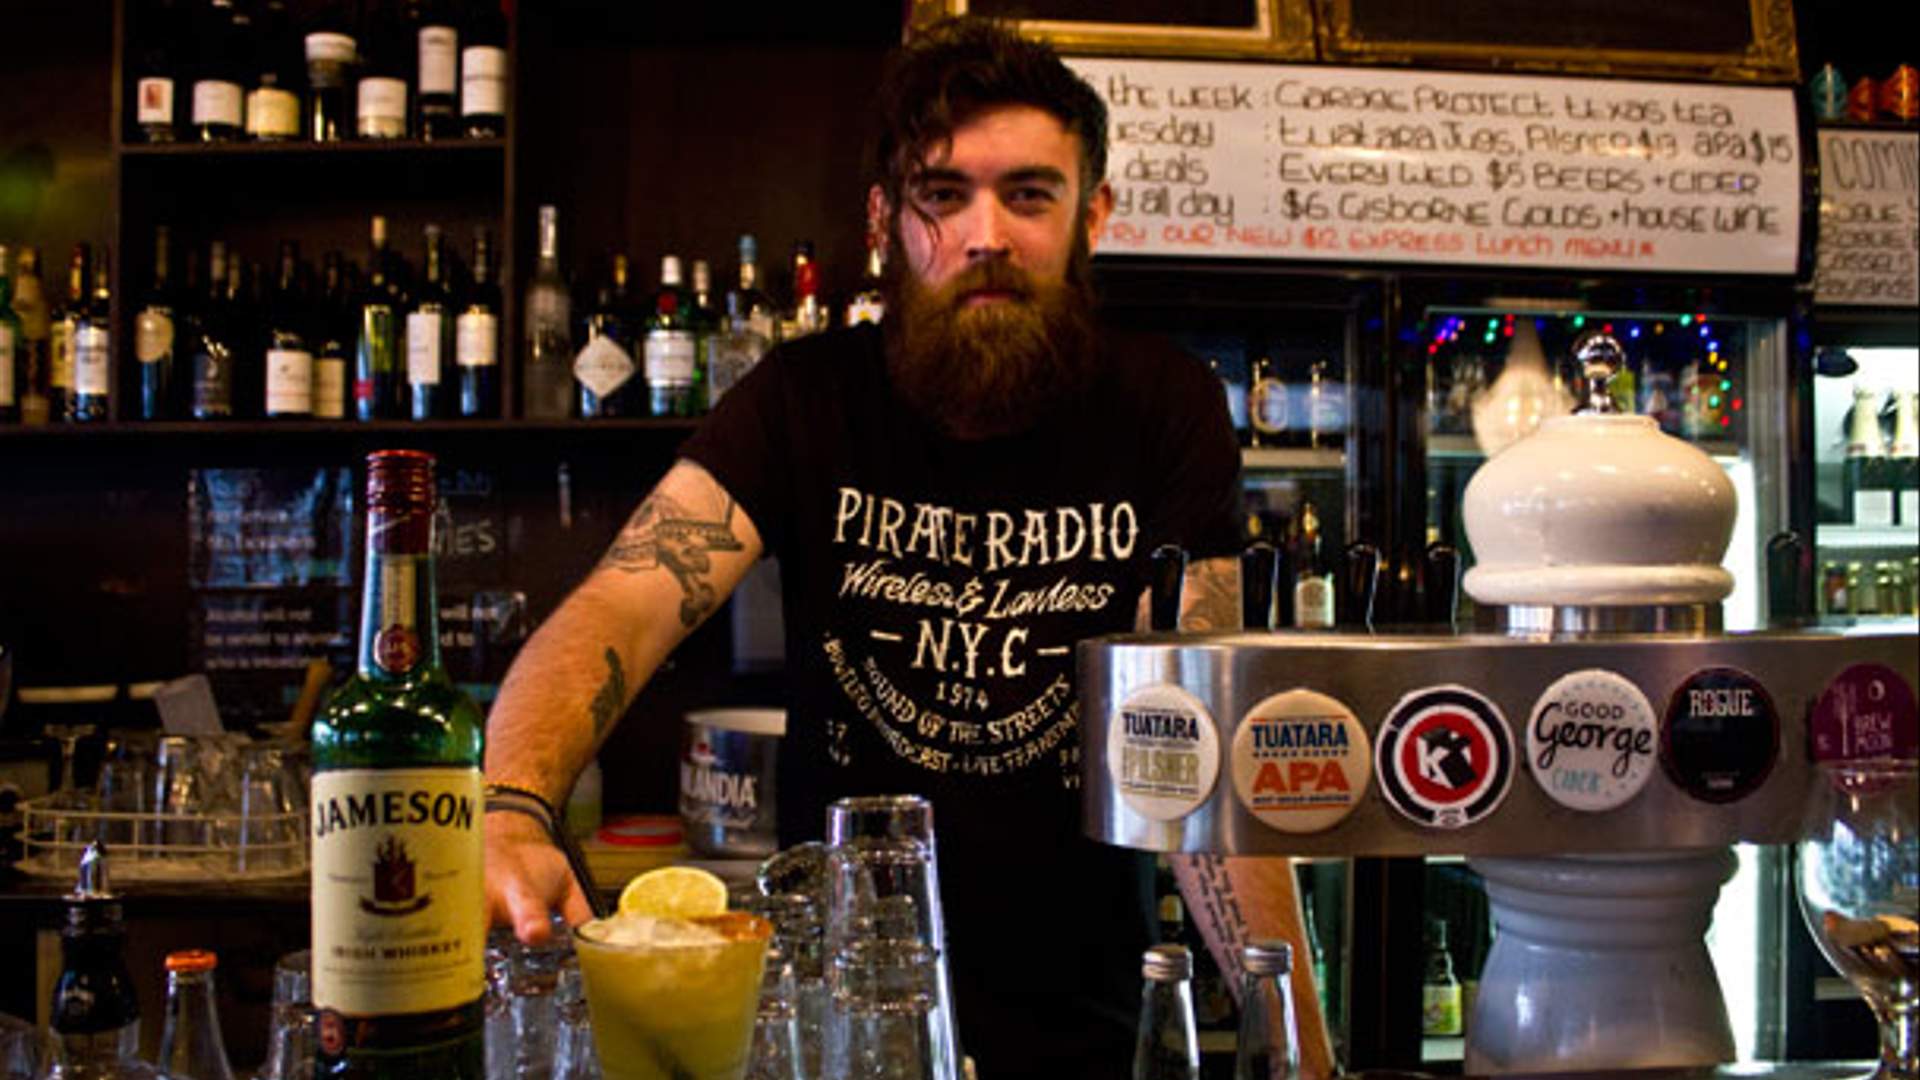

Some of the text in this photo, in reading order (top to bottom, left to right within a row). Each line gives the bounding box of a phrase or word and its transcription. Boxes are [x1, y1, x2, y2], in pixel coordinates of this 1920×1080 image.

[833, 487, 1139, 571] PIRATE RADIO
[935, 681, 988, 712] 1974
[949, 719, 984, 745] THE
[987, 673, 1070, 743] STREETS
[1564, 701, 1625, 720] GOOD
[1688, 688, 1756, 718] ROGUE
[1122, 711, 1199, 742] TUATARA
[1250, 722, 1350, 749] TUATARA
[1535, 702, 1653, 779] George
[1251, 760, 1352, 796] APA
[315, 789, 476, 837] JAMESON
[383, 939, 462, 960] WHISKEY
